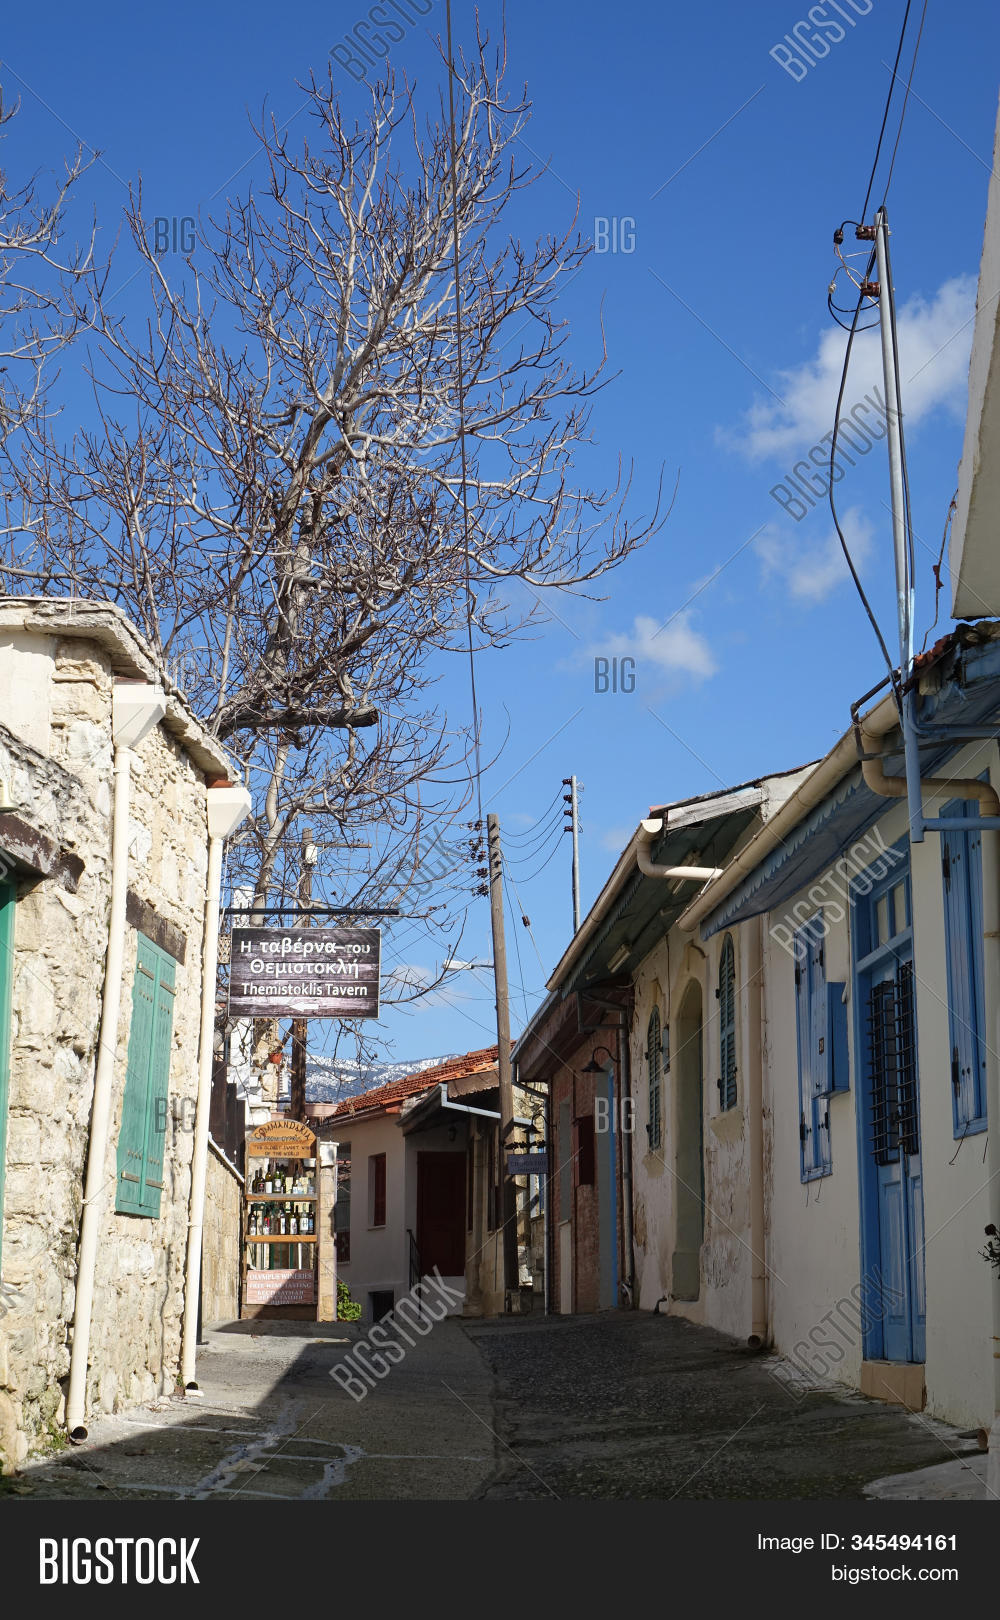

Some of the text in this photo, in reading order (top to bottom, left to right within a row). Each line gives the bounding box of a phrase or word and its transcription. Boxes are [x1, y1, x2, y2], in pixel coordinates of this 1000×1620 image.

[250, 958, 359, 979] Θεμιστοκλή
[241, 982, 368, 996] Themistoklis Tavern
